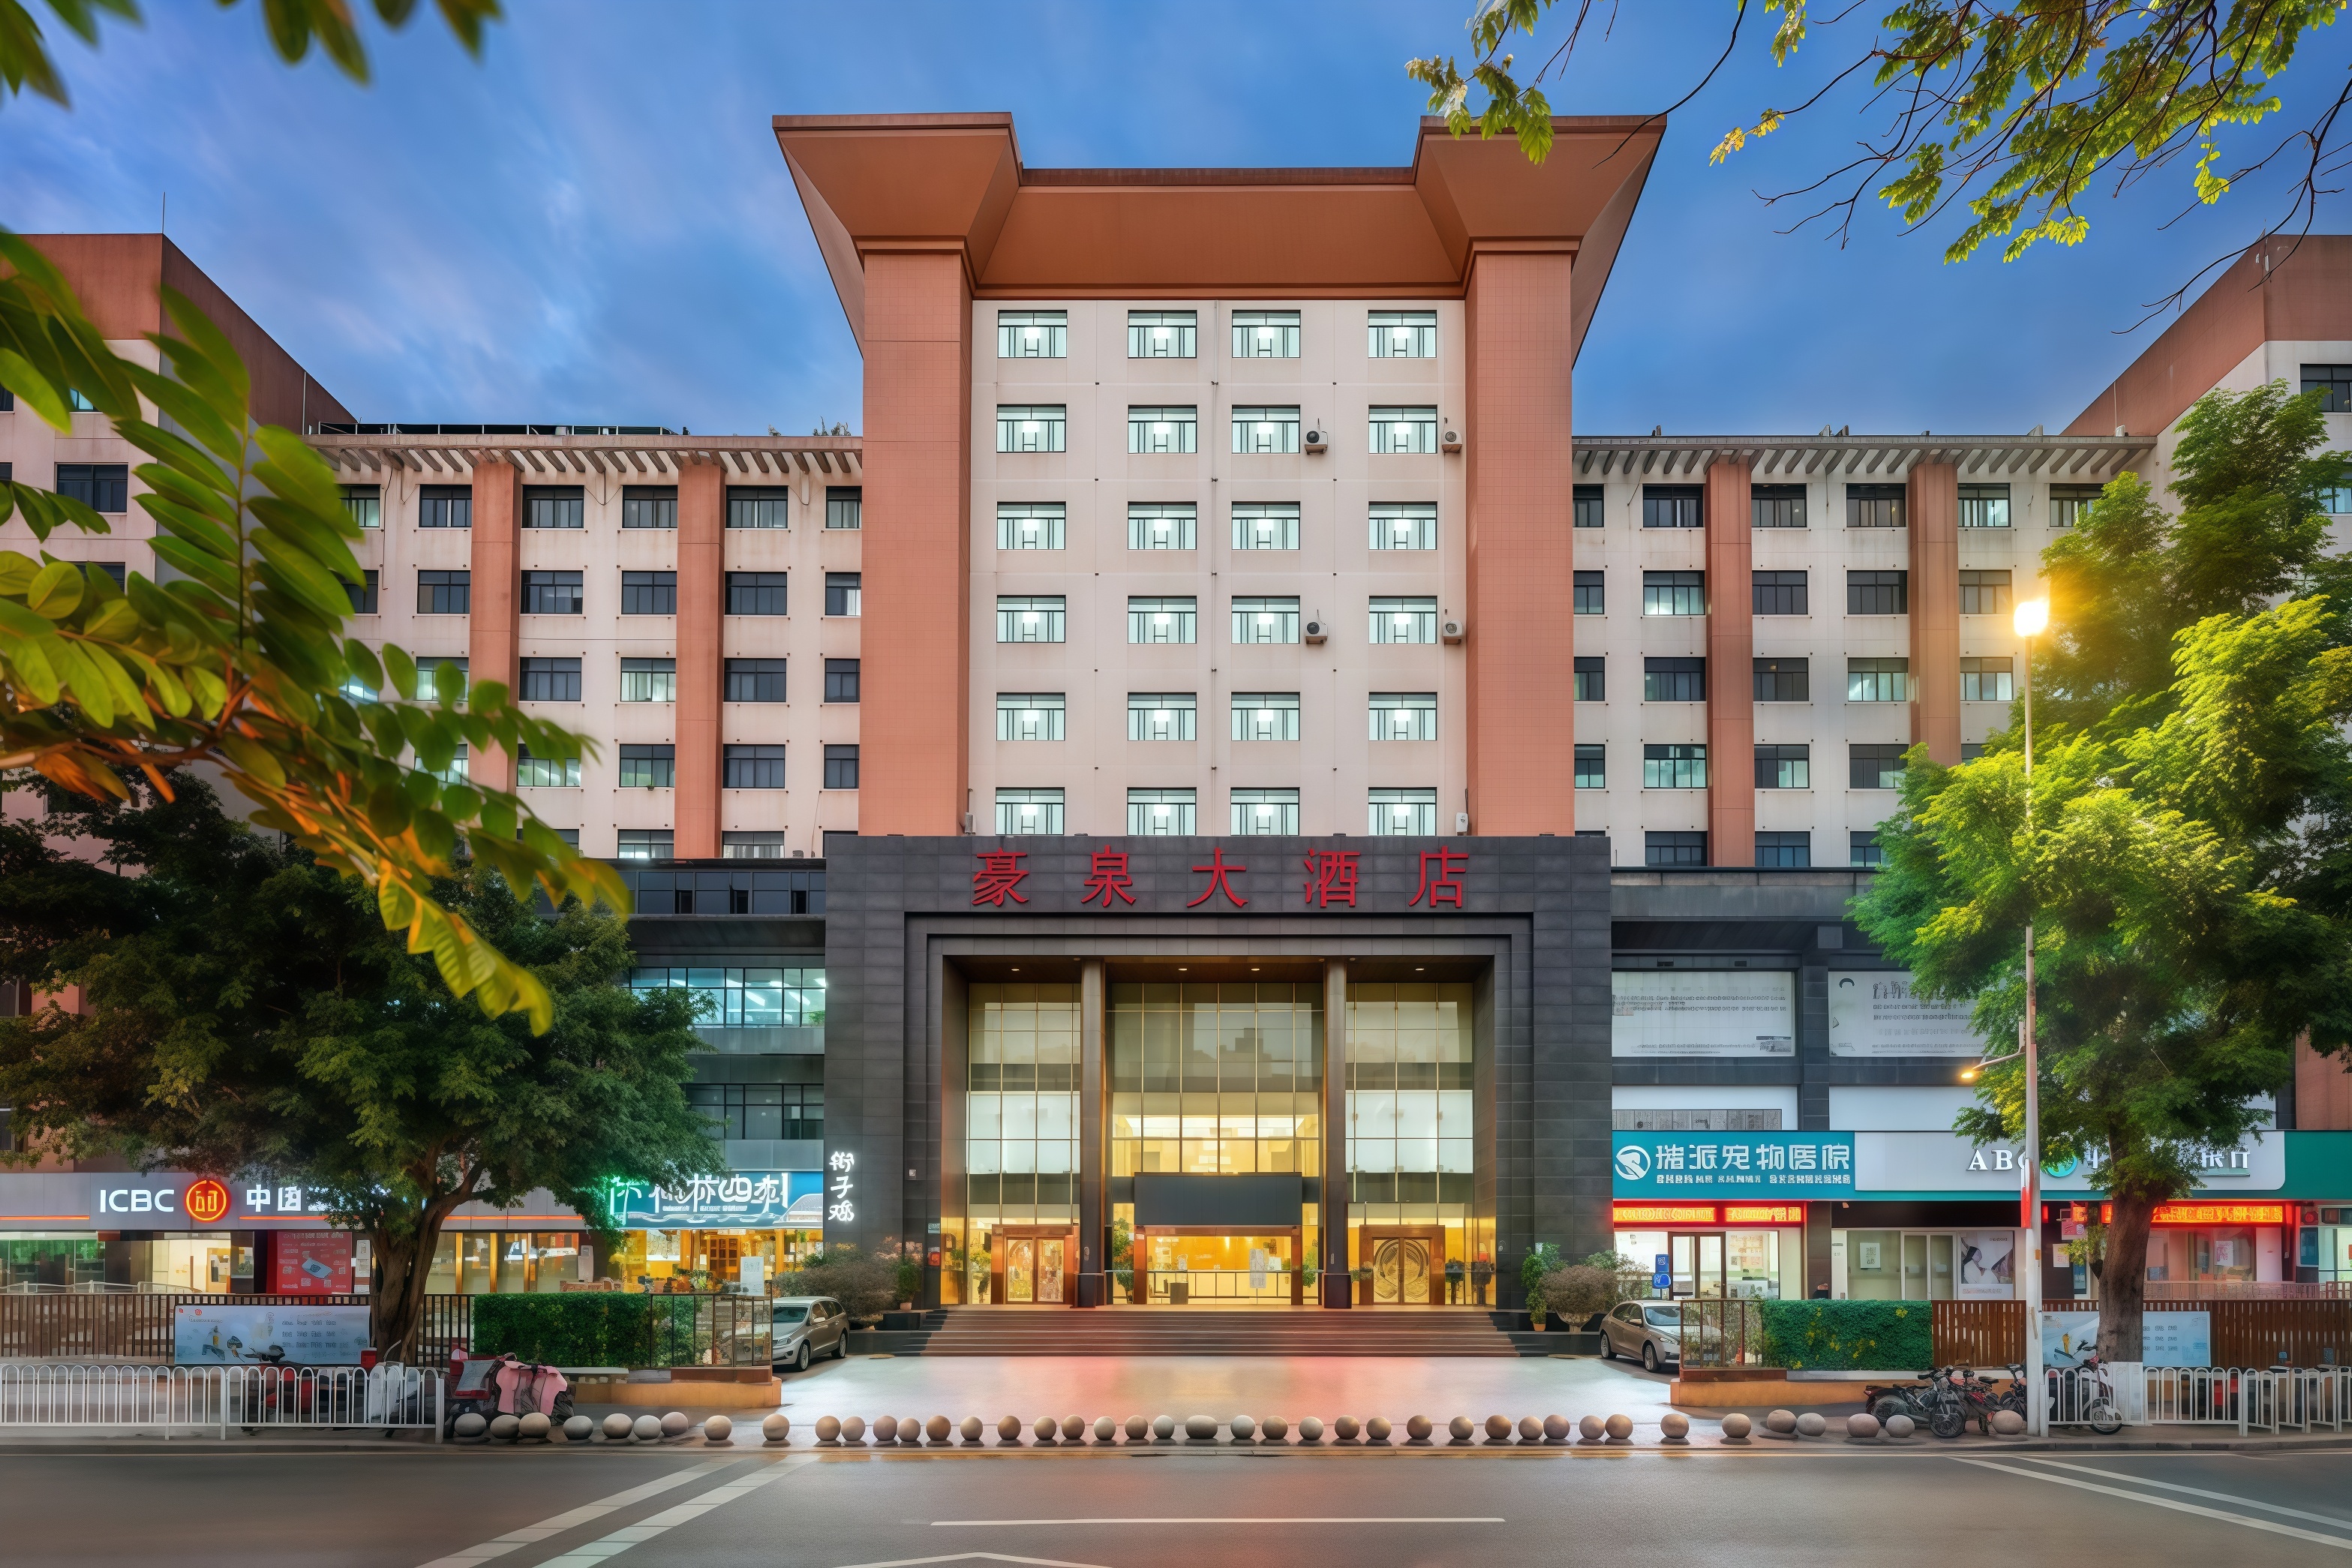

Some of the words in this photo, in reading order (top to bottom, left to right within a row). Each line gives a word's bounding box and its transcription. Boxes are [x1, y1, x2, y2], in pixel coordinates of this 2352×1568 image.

[972, 845, 1469, 909] 豪泉大酒店
[100, 1189, 174, 1212] ICBC
